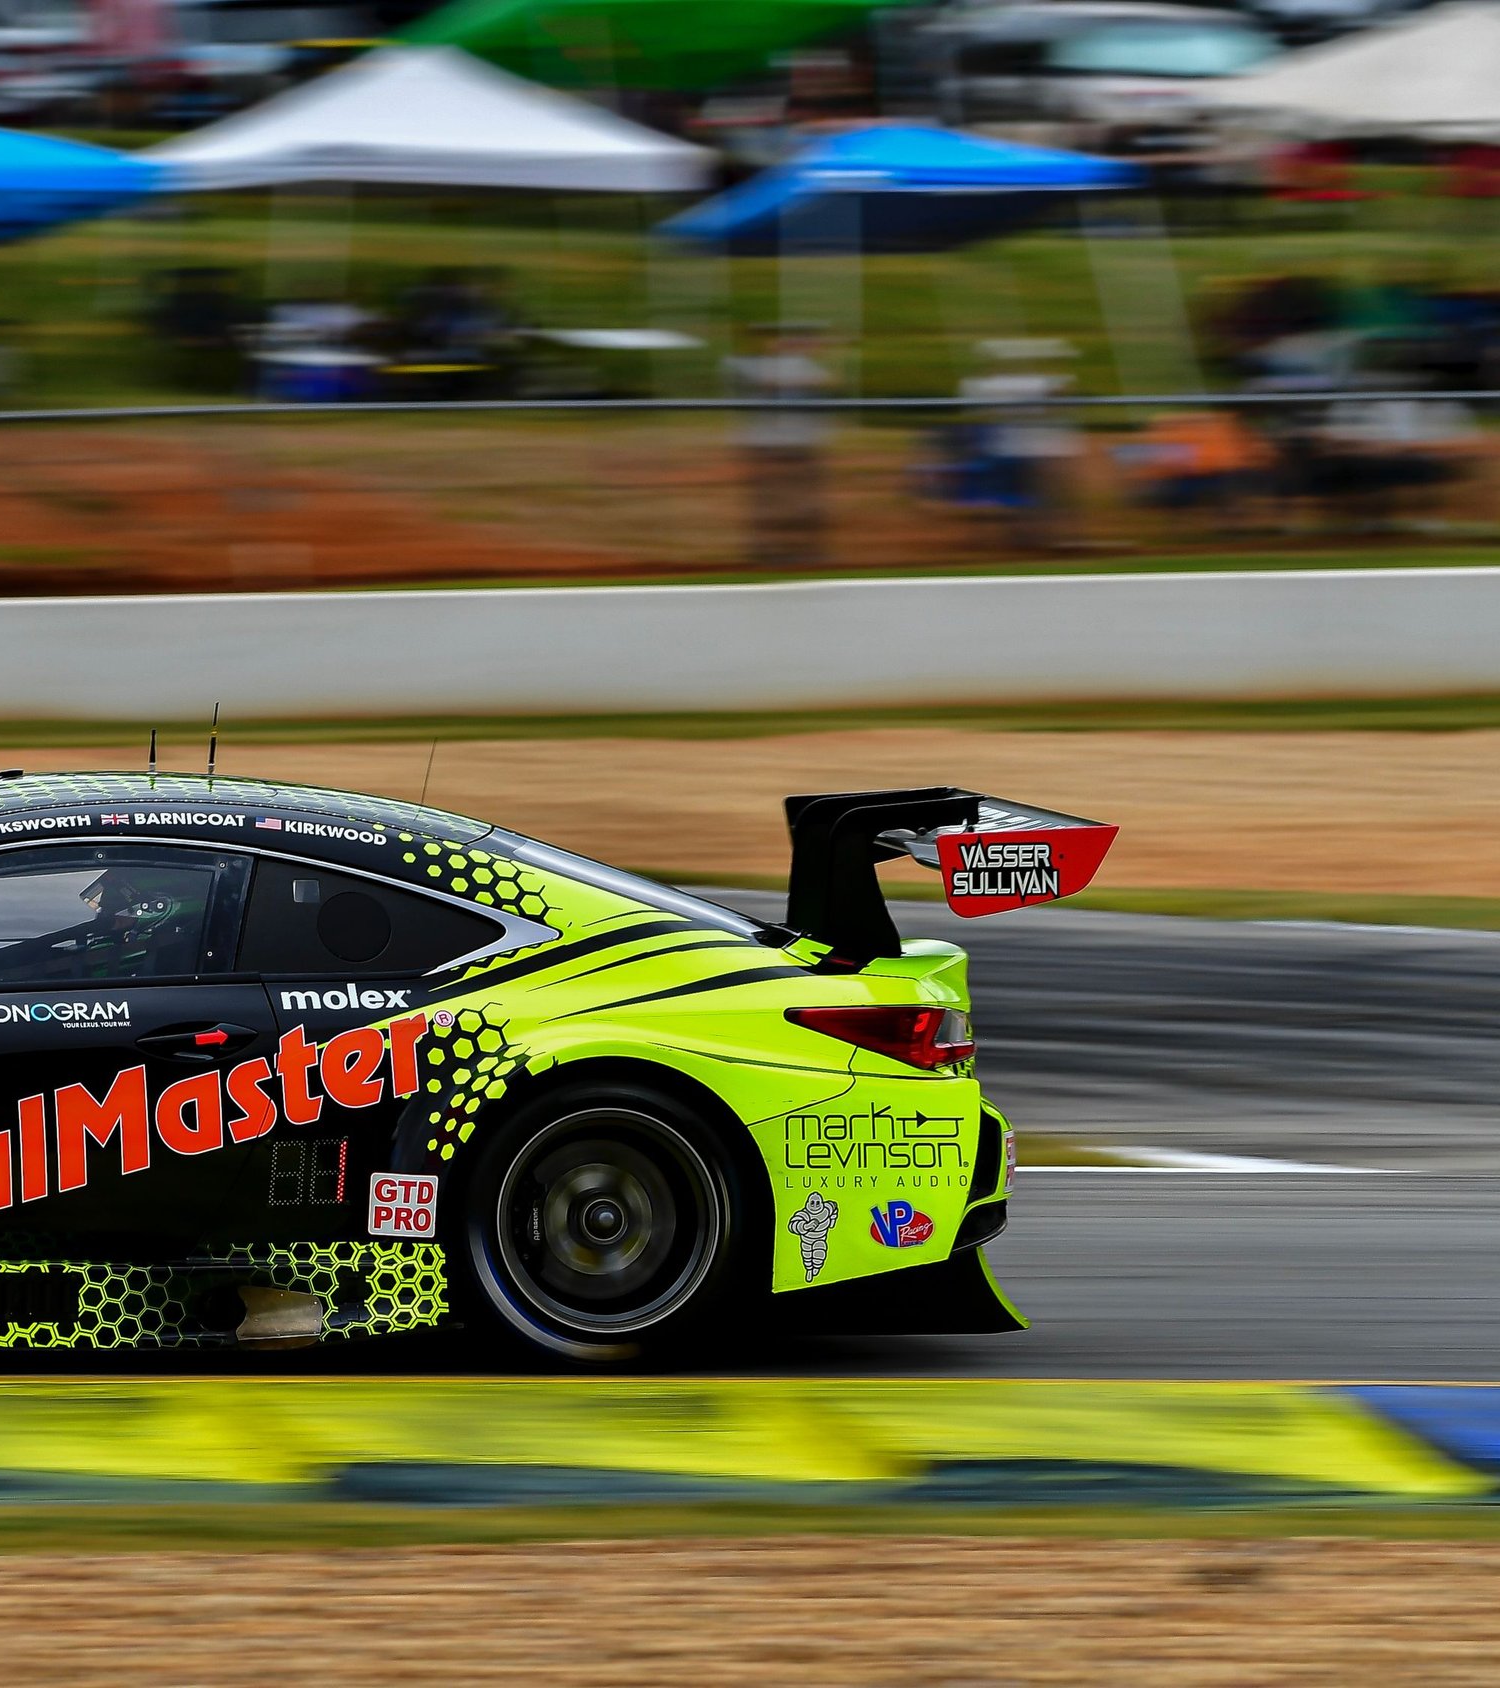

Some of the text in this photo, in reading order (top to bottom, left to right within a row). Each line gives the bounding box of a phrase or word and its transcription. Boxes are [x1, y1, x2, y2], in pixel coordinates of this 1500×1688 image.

[134, 812, 246, 827] BARNICOAT
[284, 819, 388, 846] KIRKWOOD
[960, 842, 1051, 871] VASSER
[952, 868, 1059, 897] SULLIVAN
[280, 983, 410, 1010] molex
[784, 1102, 896, 1141] mark
[373, 1178, 435, 1205] GTD
[785, 1174, 969, 1189] LUXURY AUDIO
[373, 1206, 433, 1232] PRO
[869, 1199, 914, 1248] VP
[900, 1222, 933, 1242] Racing
